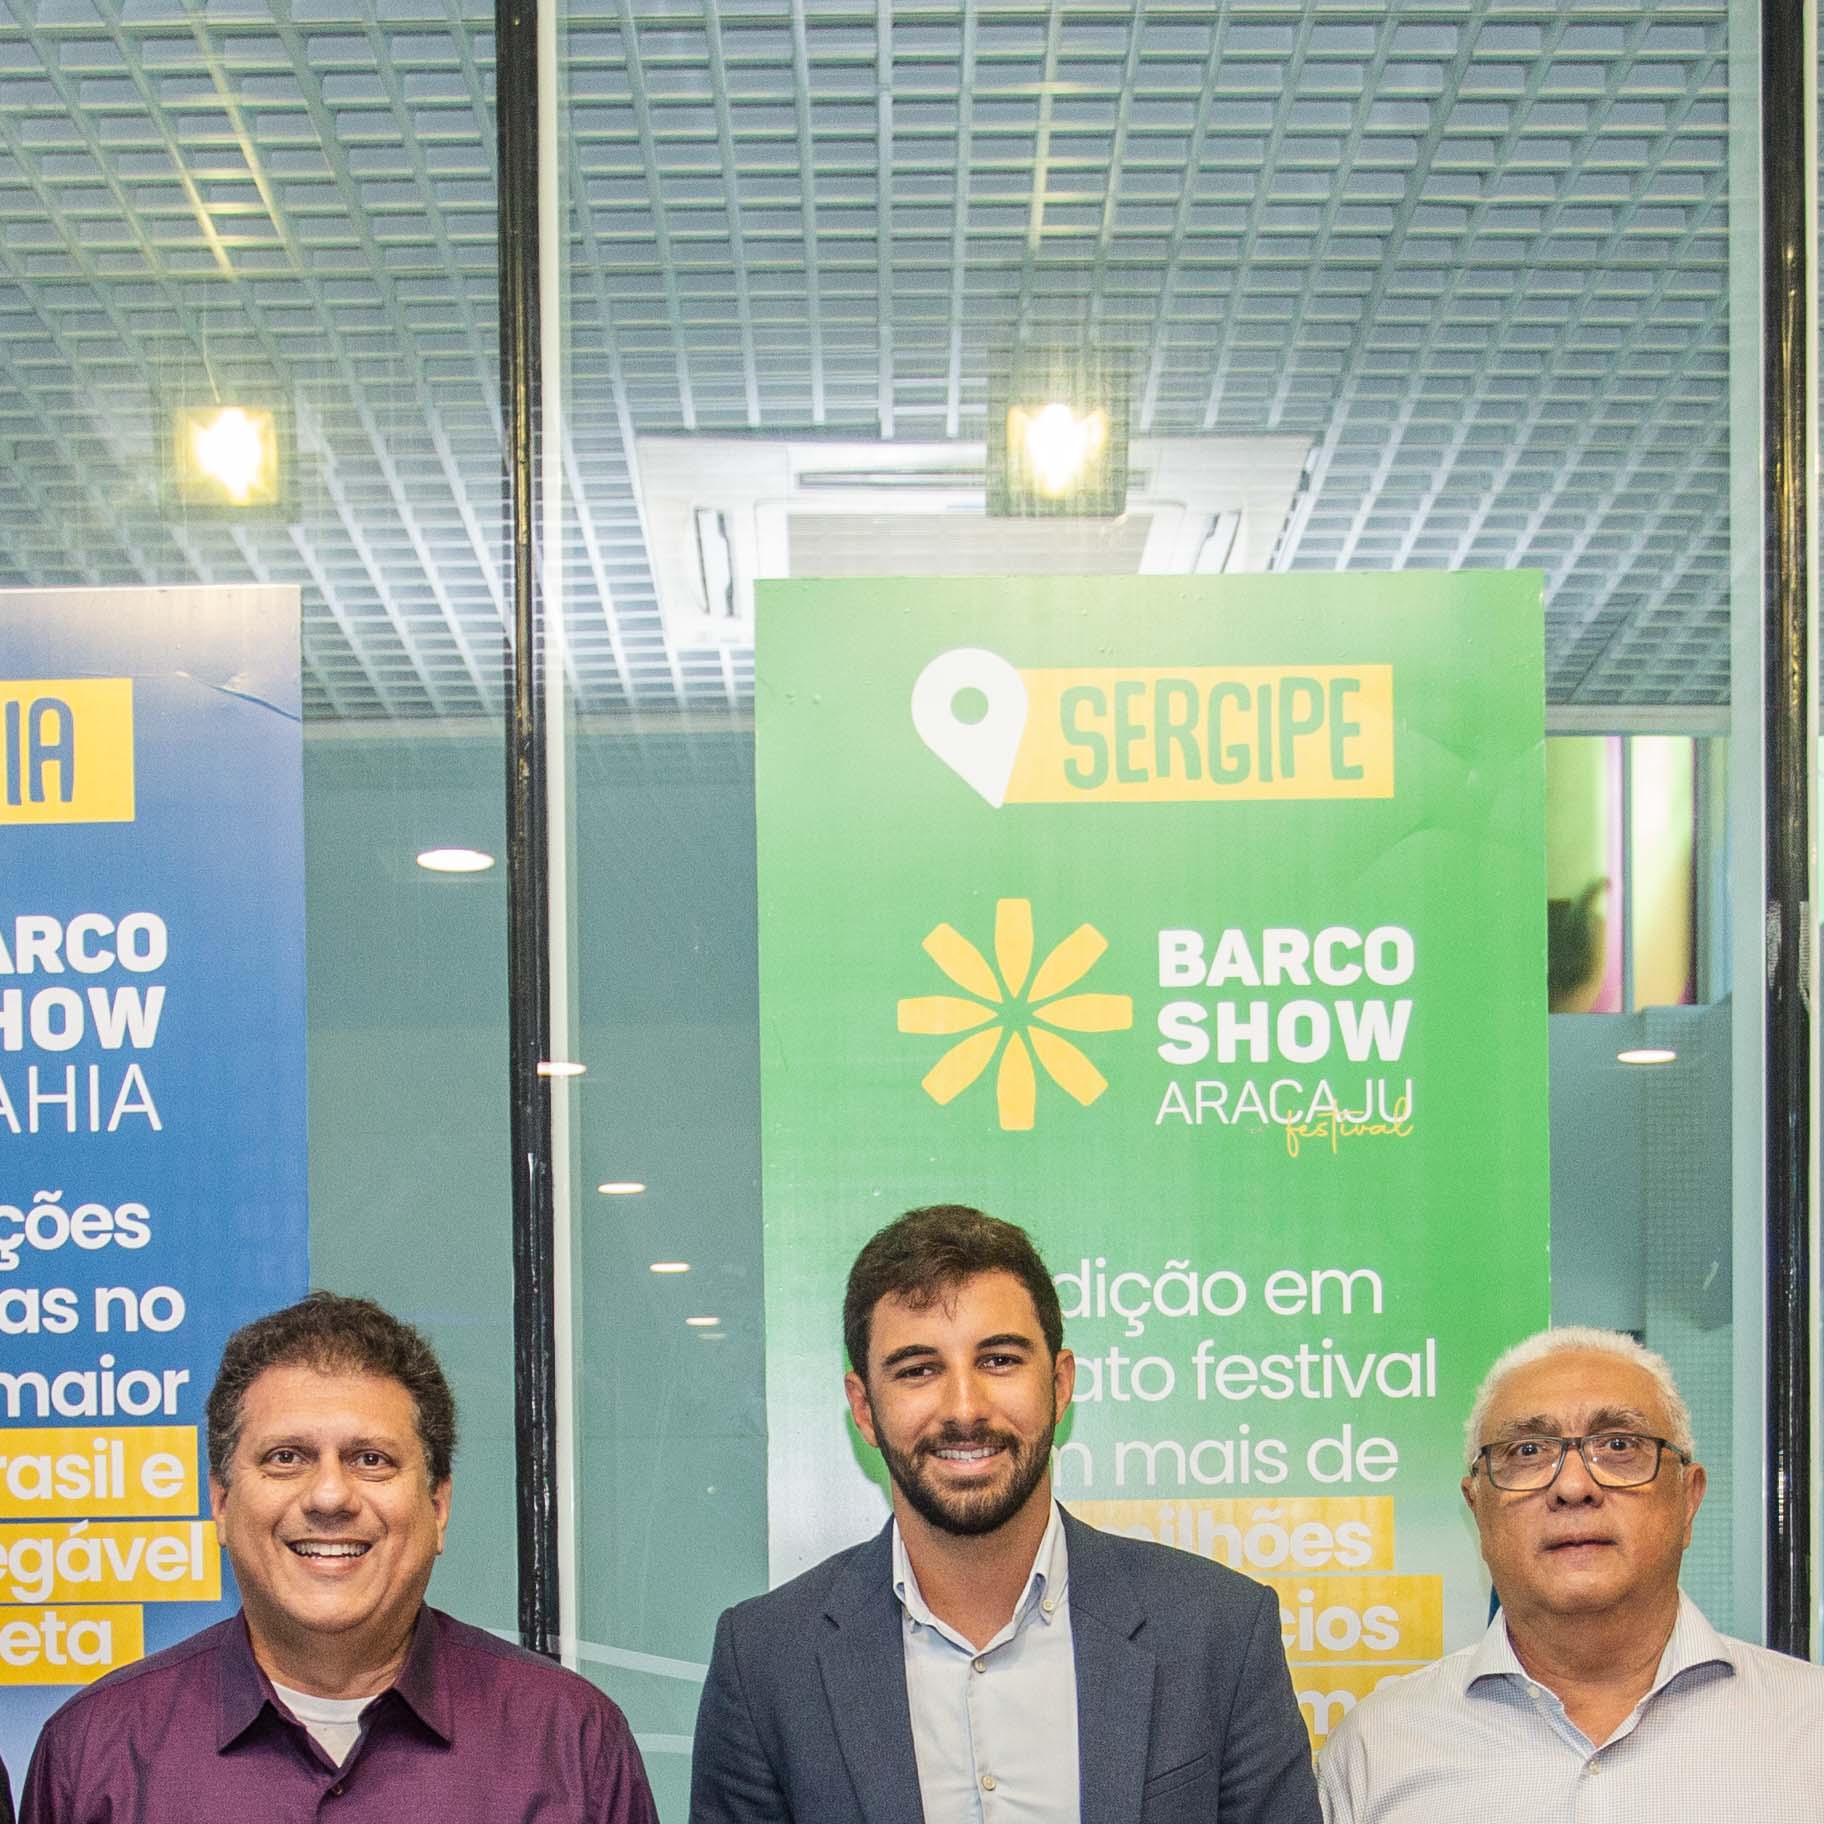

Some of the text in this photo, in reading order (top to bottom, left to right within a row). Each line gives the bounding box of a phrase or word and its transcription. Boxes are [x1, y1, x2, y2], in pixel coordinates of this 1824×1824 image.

[1058, 676, 1365, 791] SERGIPE
[1157, 926, 1416, 988] BARCO
[1156, 999, 1414, 1066] SHOW
[1154, 1078, 1414, 1126] ARACAJU
[1285, 1095, 1414, 1158] festival
[95, 1284, 188, 1334] no
[1052, 1255, 1384, 1340] dição em
[1073, 1336, 1437, 1403] ato festival
[139, 1451, 187, 1499] e
[1113, 1422, 1290, 1487] mais
[1307, 1423, 1400, 1485] de
